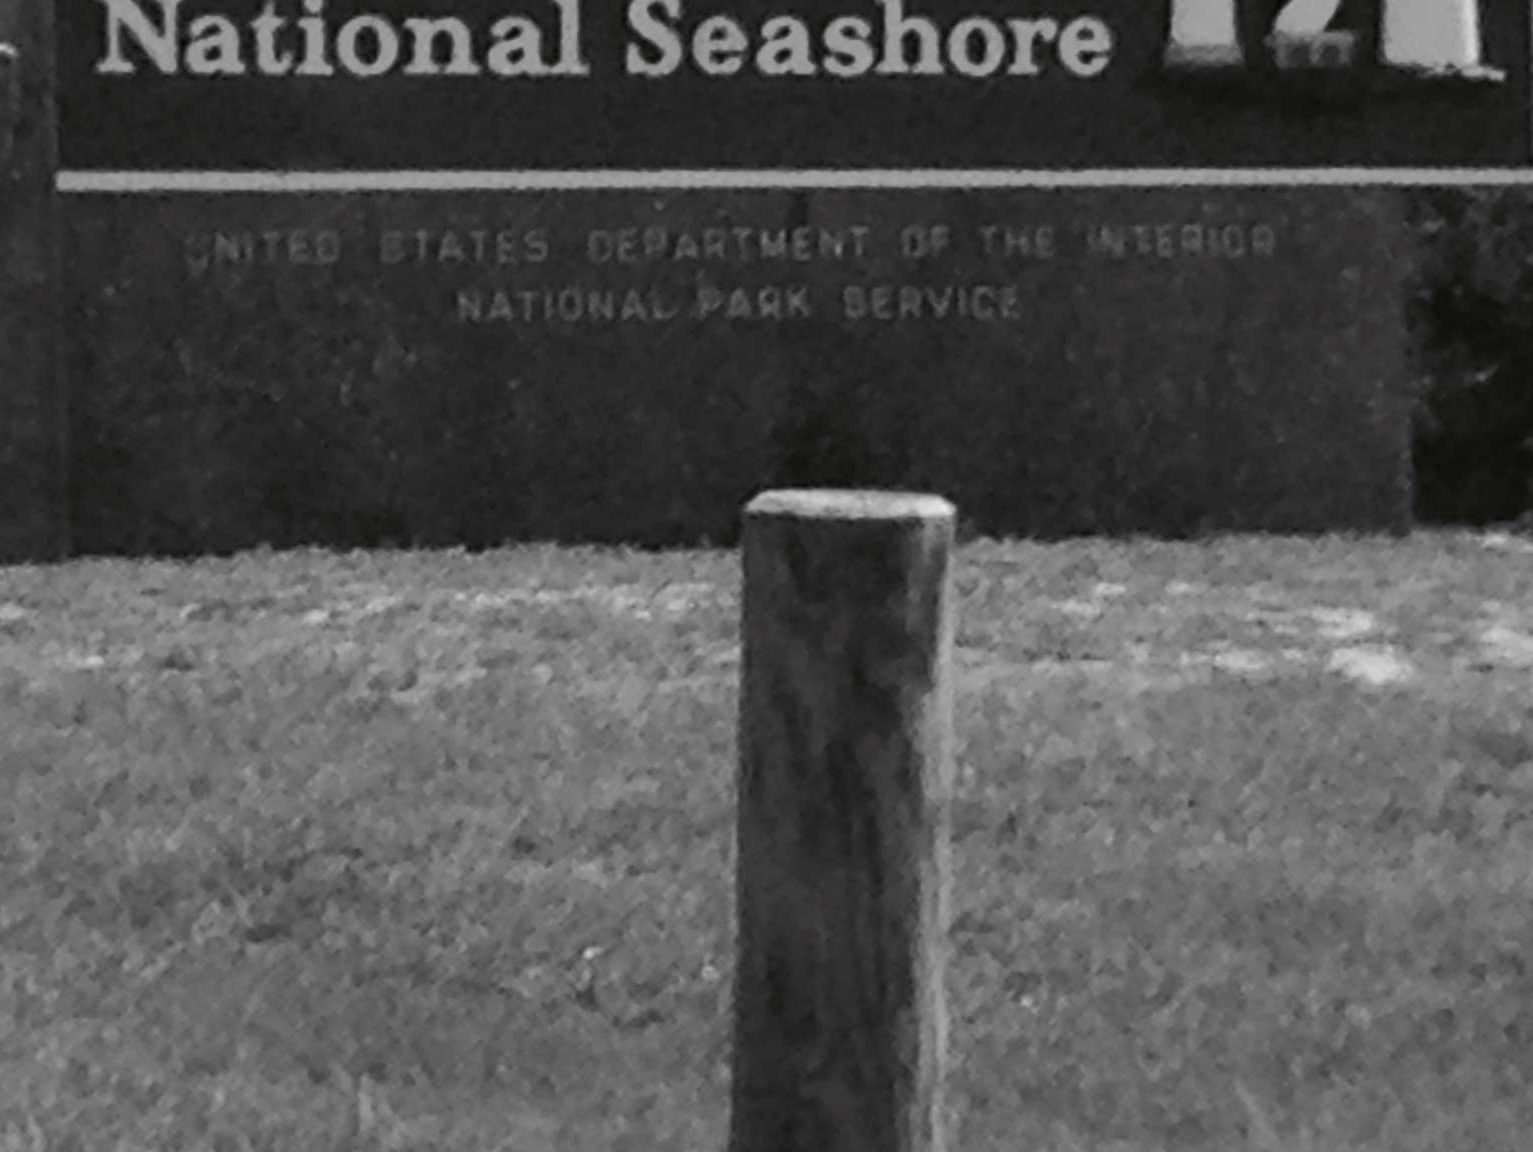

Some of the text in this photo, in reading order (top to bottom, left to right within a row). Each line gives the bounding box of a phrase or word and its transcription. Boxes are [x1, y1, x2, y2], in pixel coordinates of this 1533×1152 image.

[183, 223, 1275, 267] UNITED STATES DEPARTMENT OF THE INTERIOR
[456, 285, 1022, 323] NATIONAL PARK SERVICE
